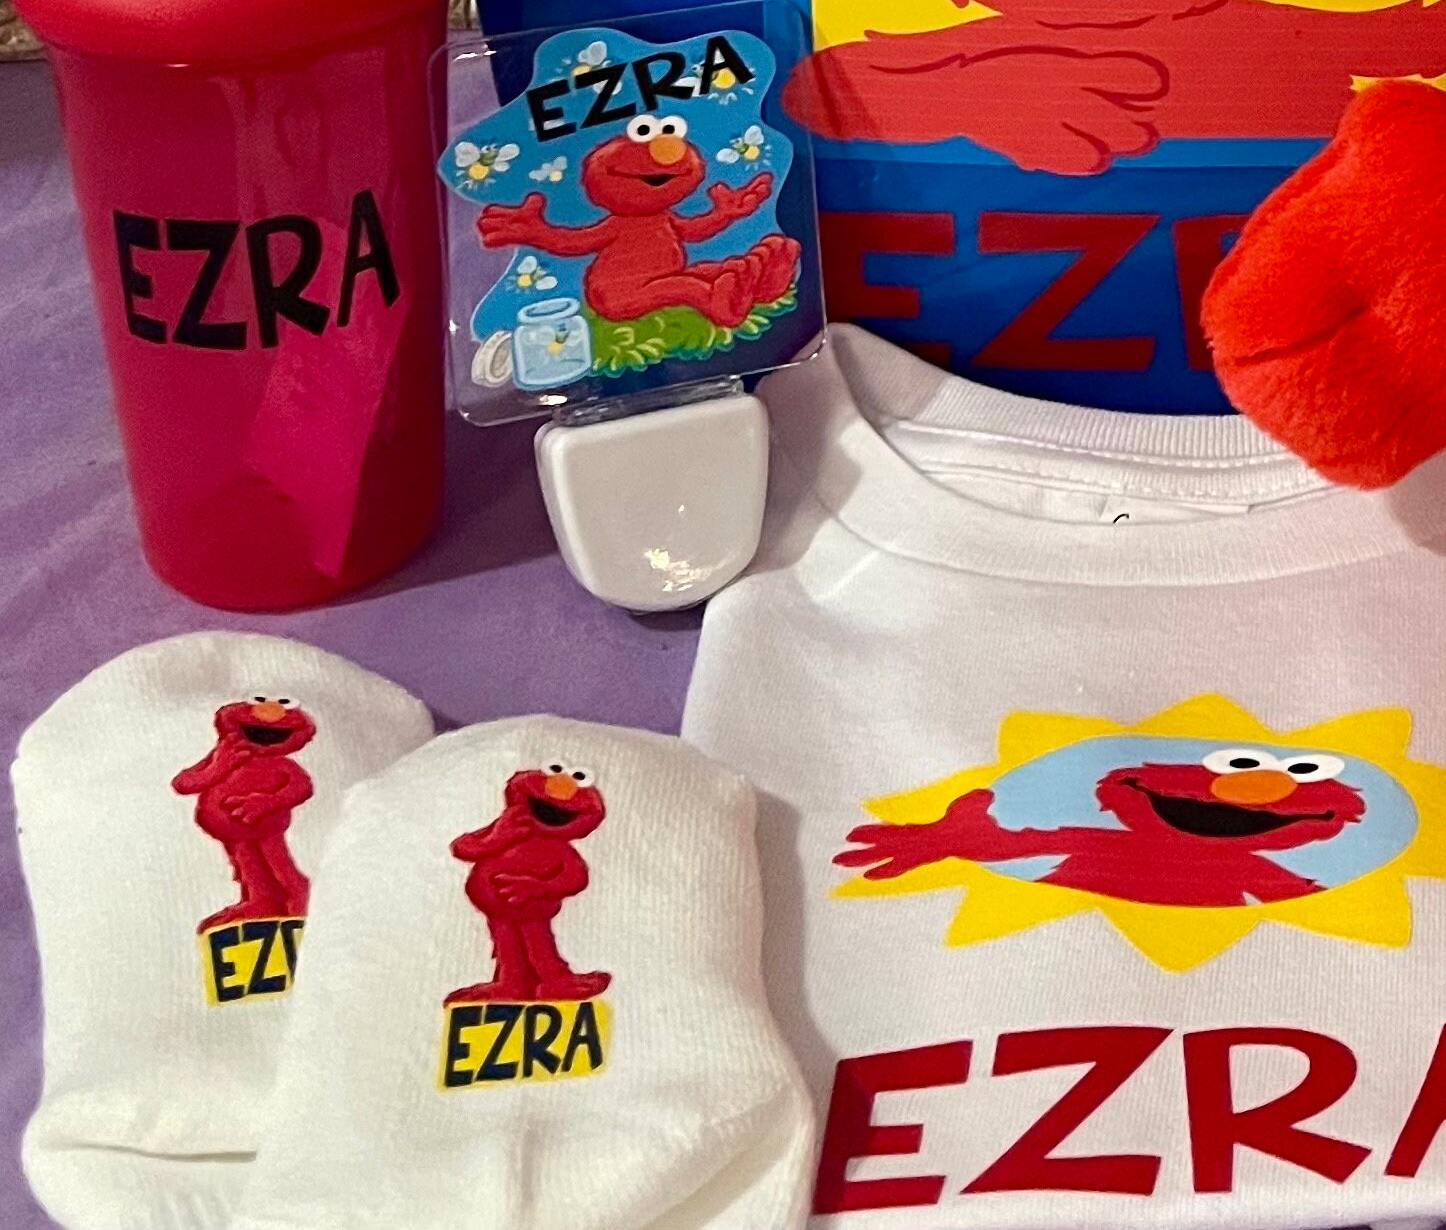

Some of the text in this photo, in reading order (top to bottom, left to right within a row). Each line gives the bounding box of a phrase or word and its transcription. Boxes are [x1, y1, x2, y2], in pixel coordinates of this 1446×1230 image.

[525, 35, 756, 143] EZRA
[113, 189, 401, 351] EZRA
[443, 1001, 603, 1088] EZRA
